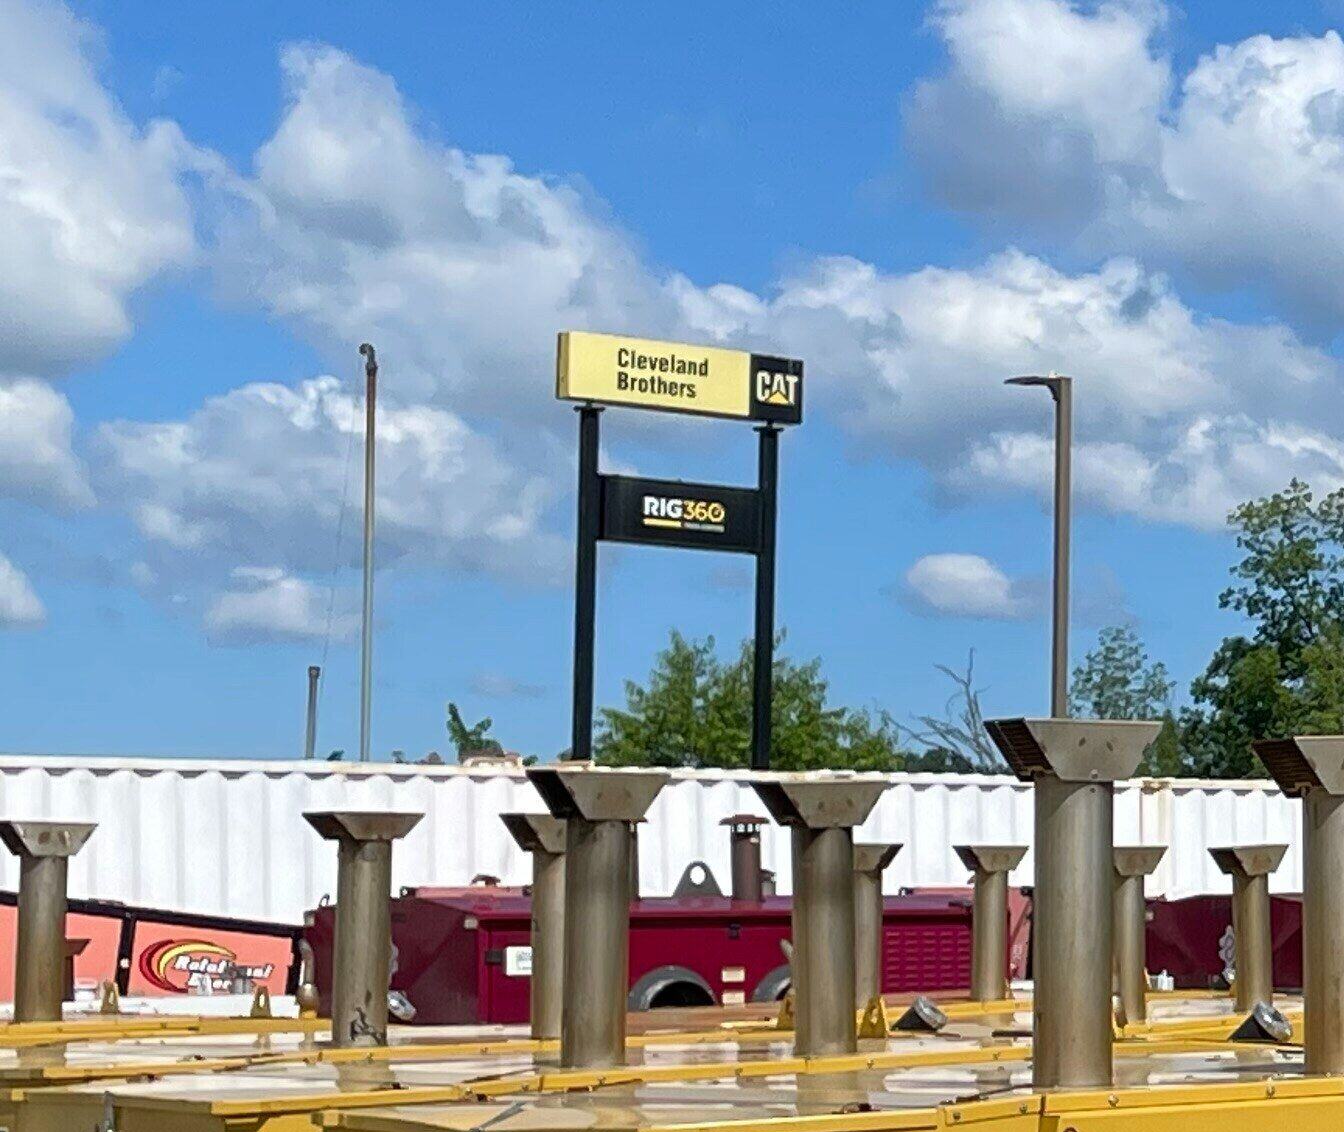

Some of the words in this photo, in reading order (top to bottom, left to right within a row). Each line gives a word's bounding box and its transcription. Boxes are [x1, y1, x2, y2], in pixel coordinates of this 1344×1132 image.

[617, 348, 709, 377] Cleveland
[616, 371, 697, 398] Brothers
[756, 369, 799, 405] CAT
[643, 496, 726, 523] RIG360
